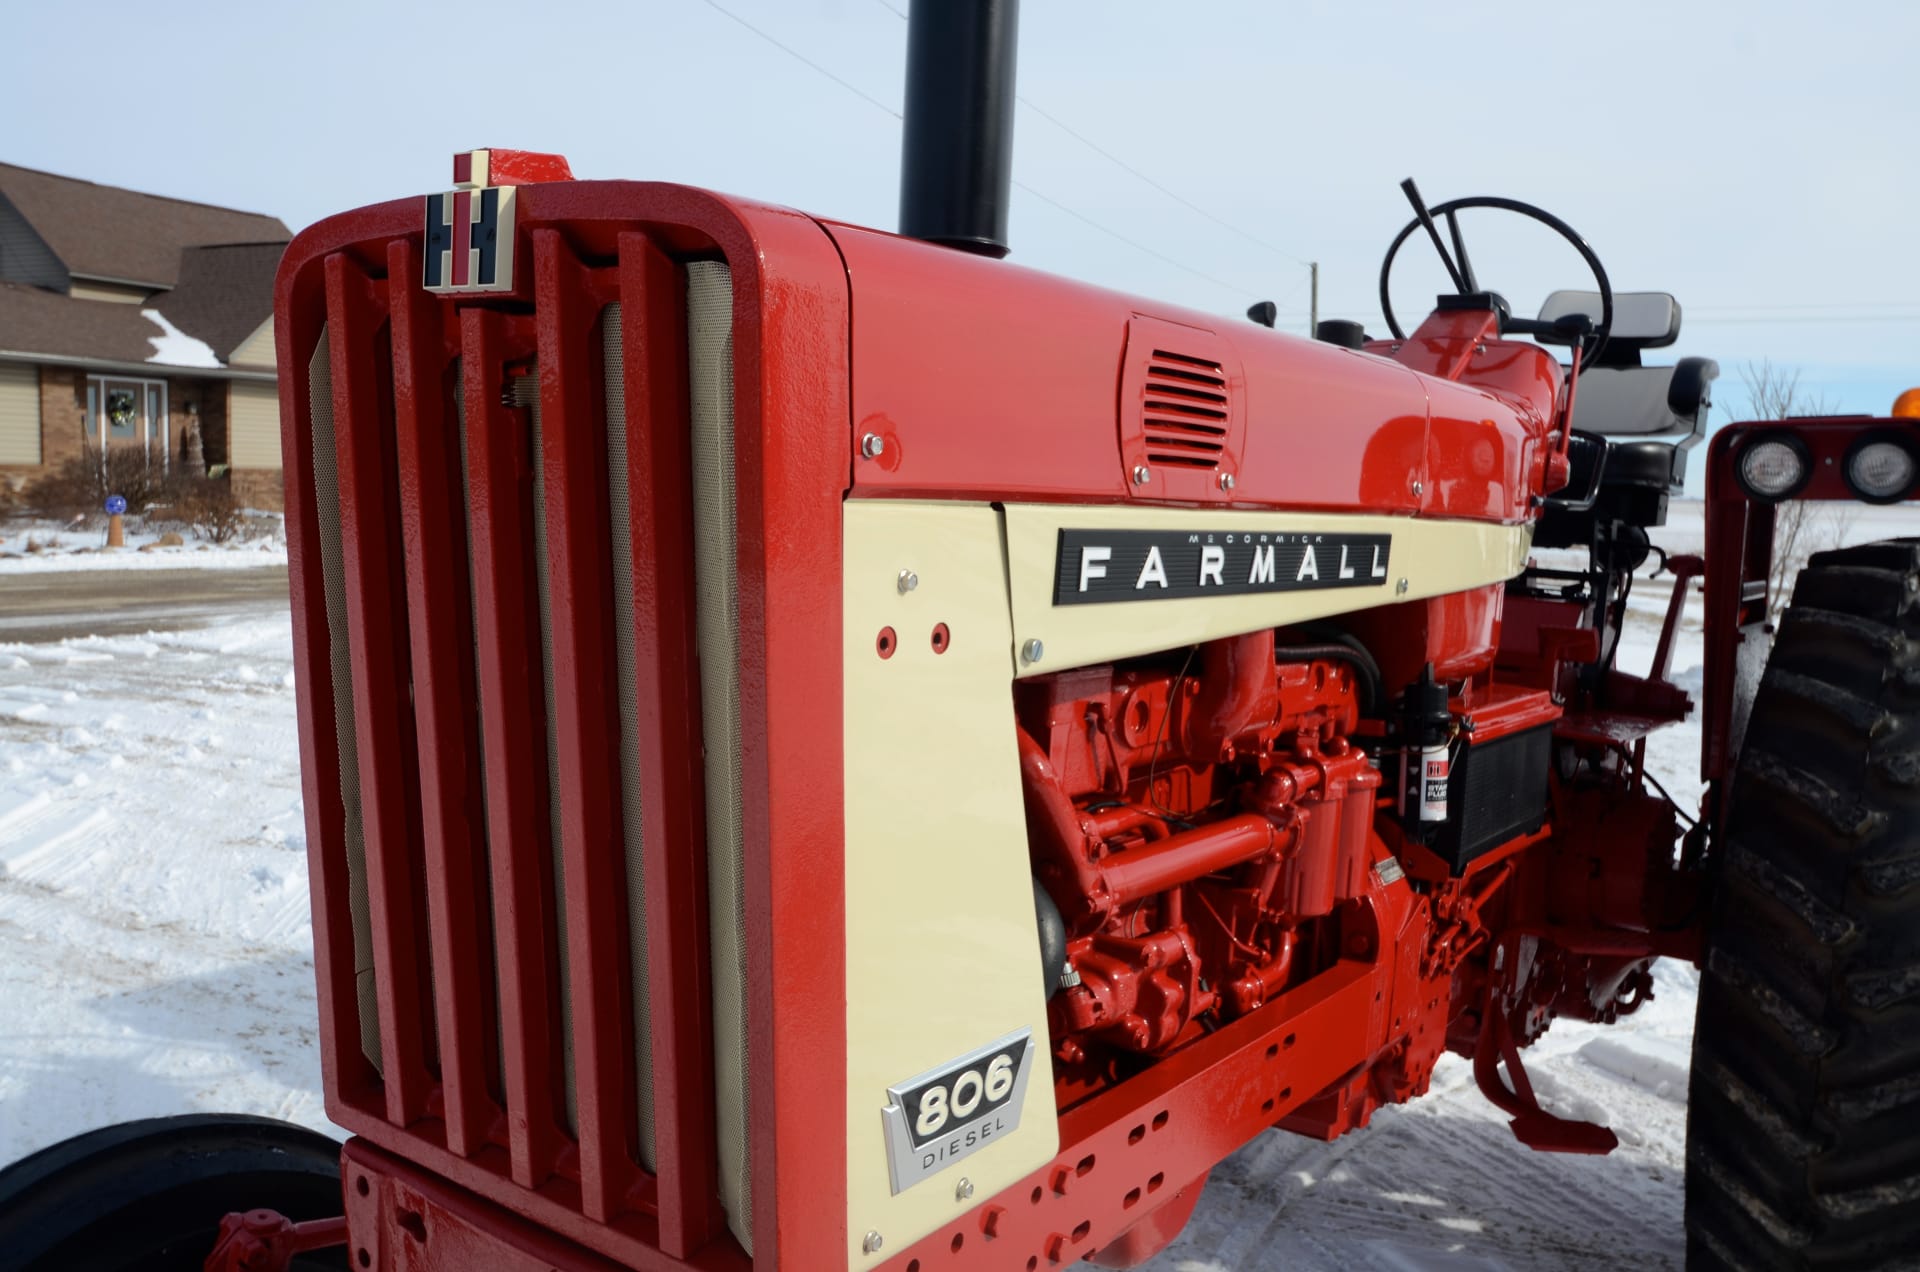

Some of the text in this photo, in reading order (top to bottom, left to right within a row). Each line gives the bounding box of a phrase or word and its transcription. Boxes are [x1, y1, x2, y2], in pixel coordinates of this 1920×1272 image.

[1079, 544, 1386, 593] FARMALL
[915, 1053, 1014, 1137] 806
[922, 1117, 1005, 1170] DIESEL
